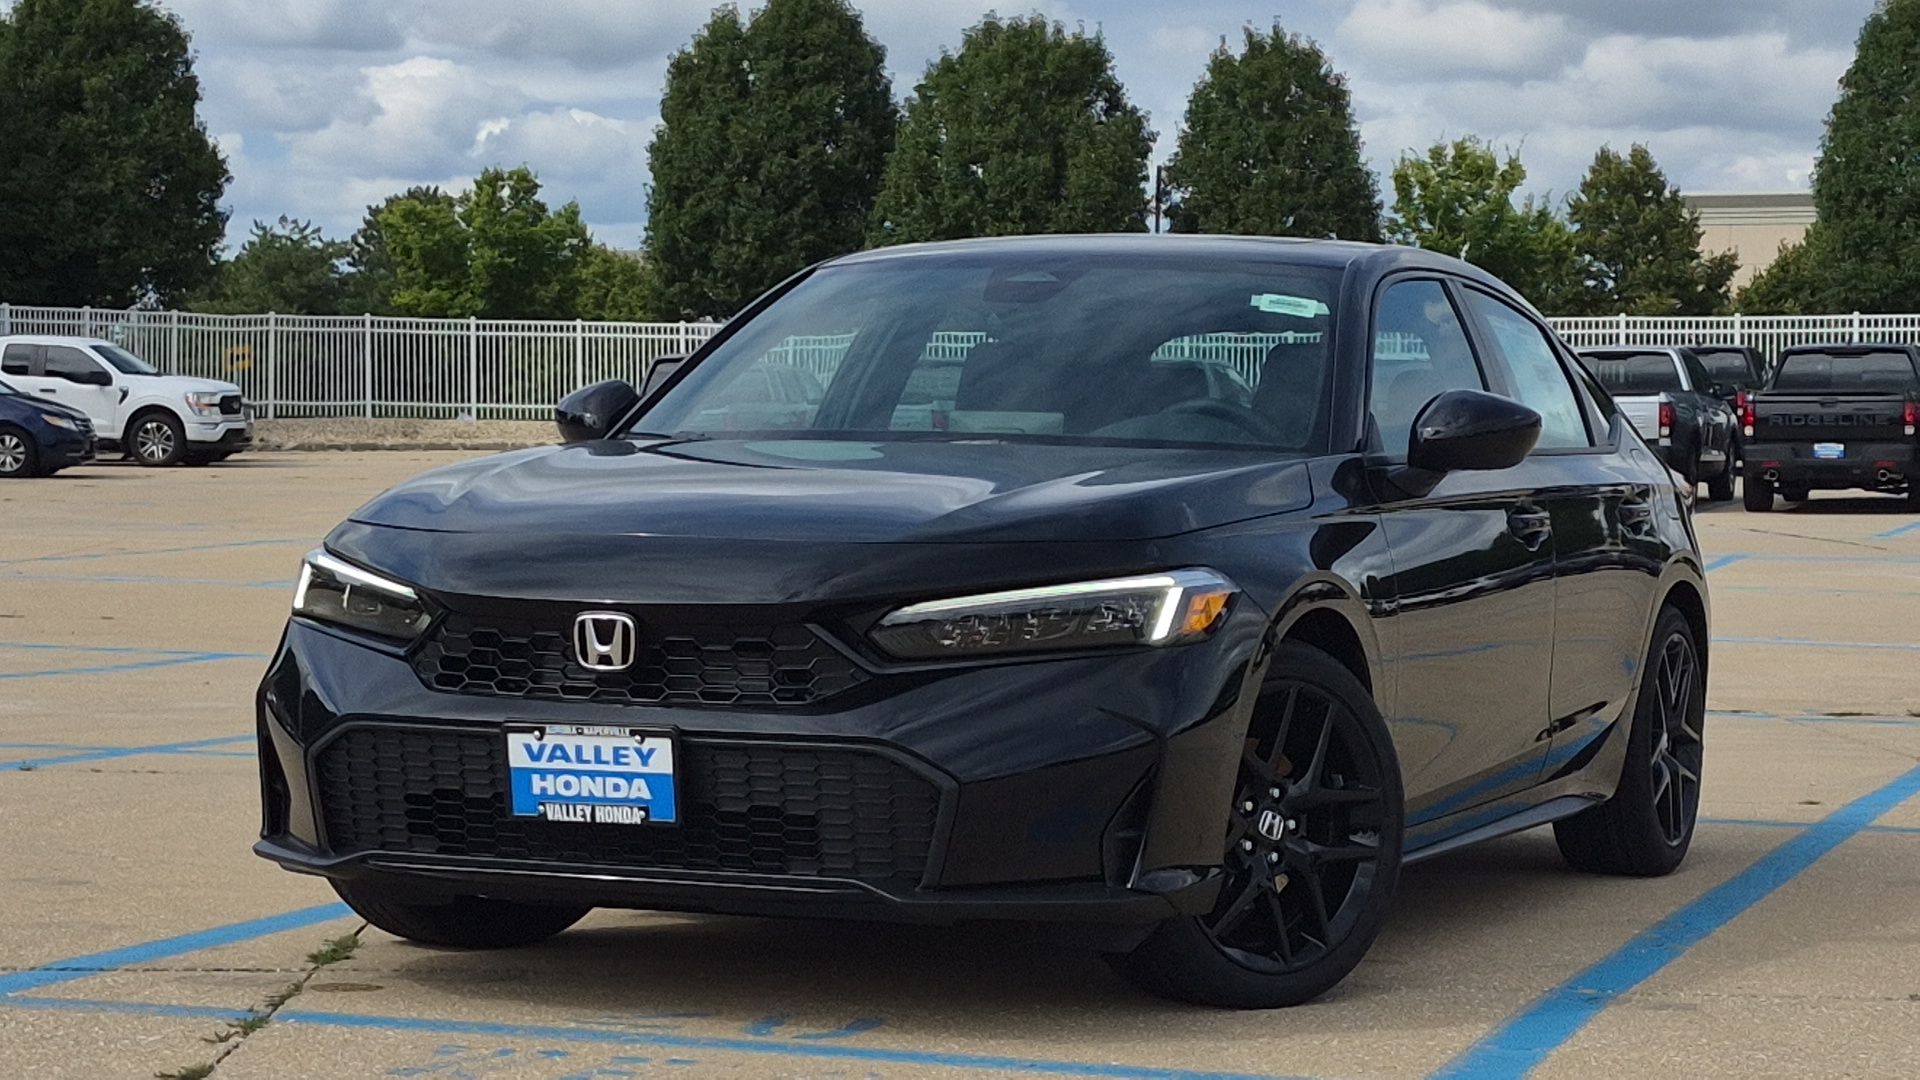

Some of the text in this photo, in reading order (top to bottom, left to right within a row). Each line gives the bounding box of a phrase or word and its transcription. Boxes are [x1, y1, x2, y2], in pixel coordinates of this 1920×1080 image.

[1769, 414, 1888, 426] RIDGELINE
[522, 742, 657, 768] VALLEY
[531, 773, 653, 800] HONDA
[545, 802, 642, 825] VALLEY HONDA
